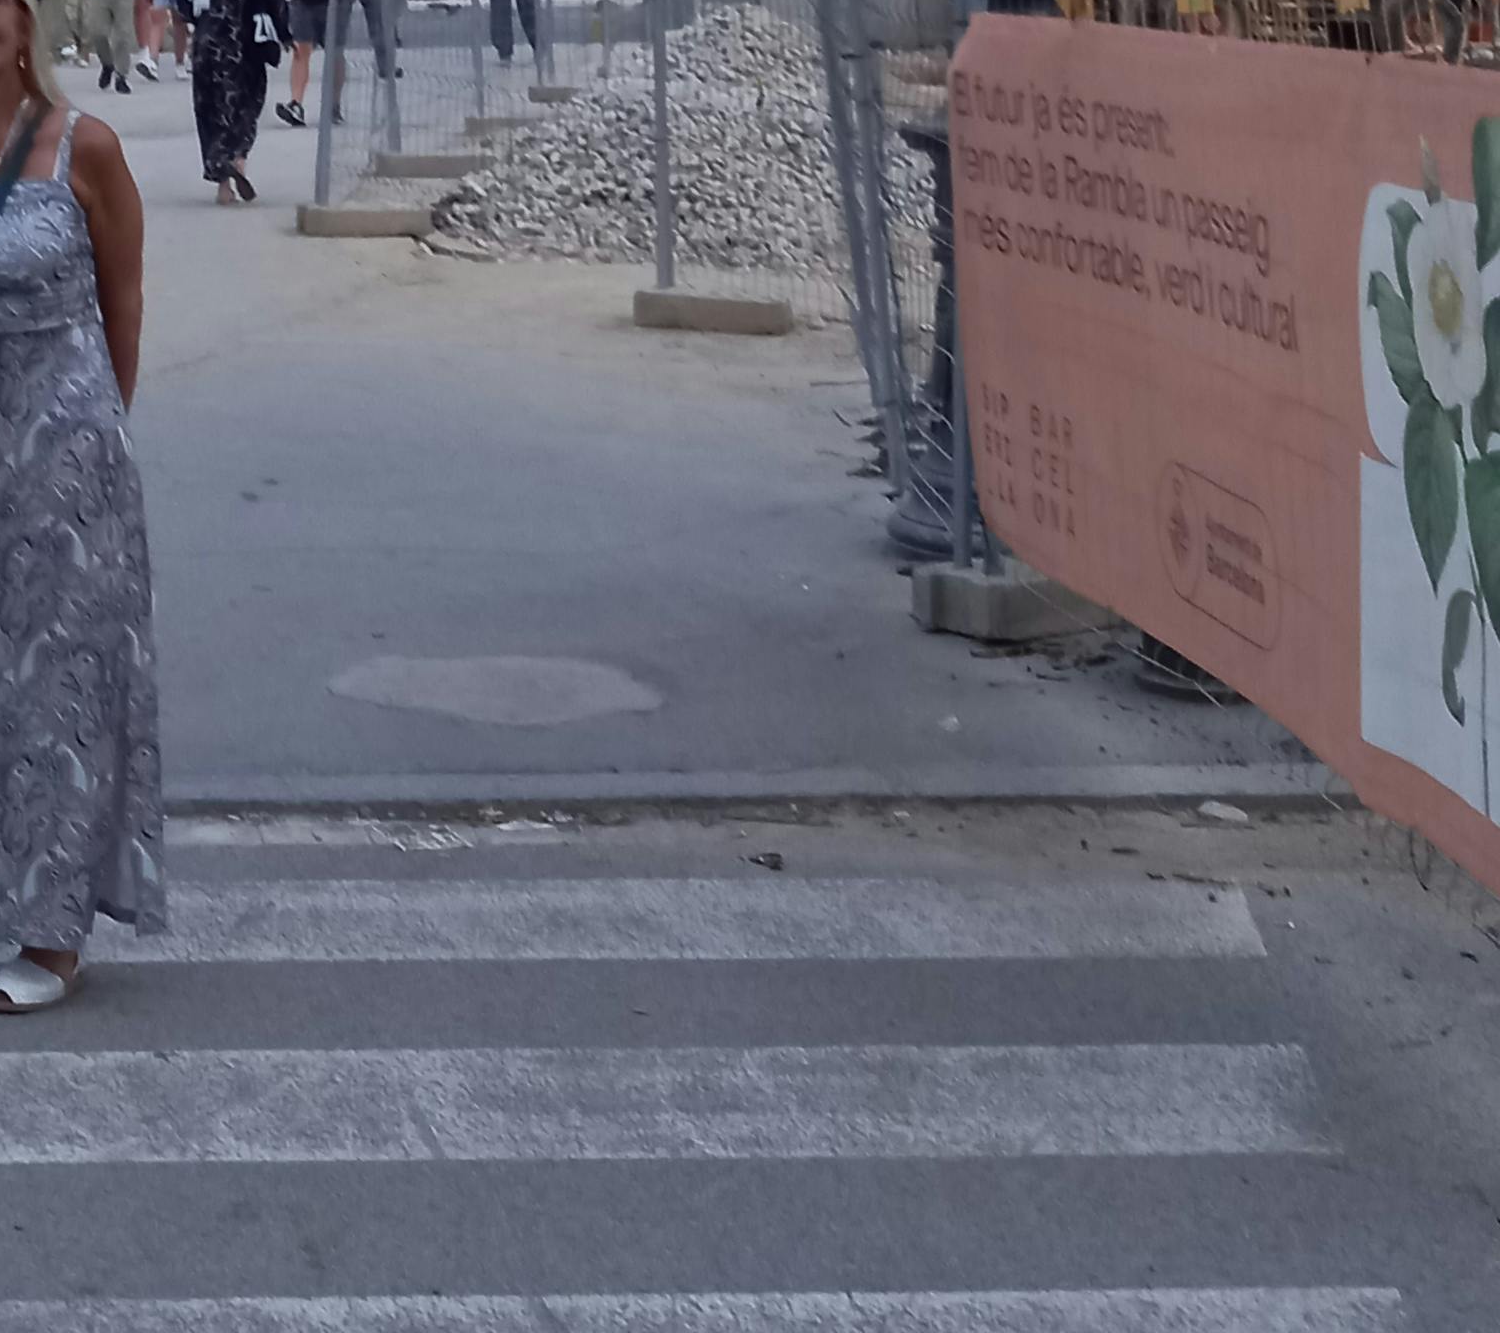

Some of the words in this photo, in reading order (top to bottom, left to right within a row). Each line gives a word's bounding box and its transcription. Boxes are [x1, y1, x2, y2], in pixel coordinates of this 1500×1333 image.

[1056, 85, 1088, 138] és
[1003, 142, 1034, 197] de
[1037, 145, 1058, 200] la
[1062, 153, 1149, 223] Rambla
[1151, 185, 1181, 230] un
[1181, 189, 1270, 279] passeig
[1216, 276, 1300, 353] cultural
